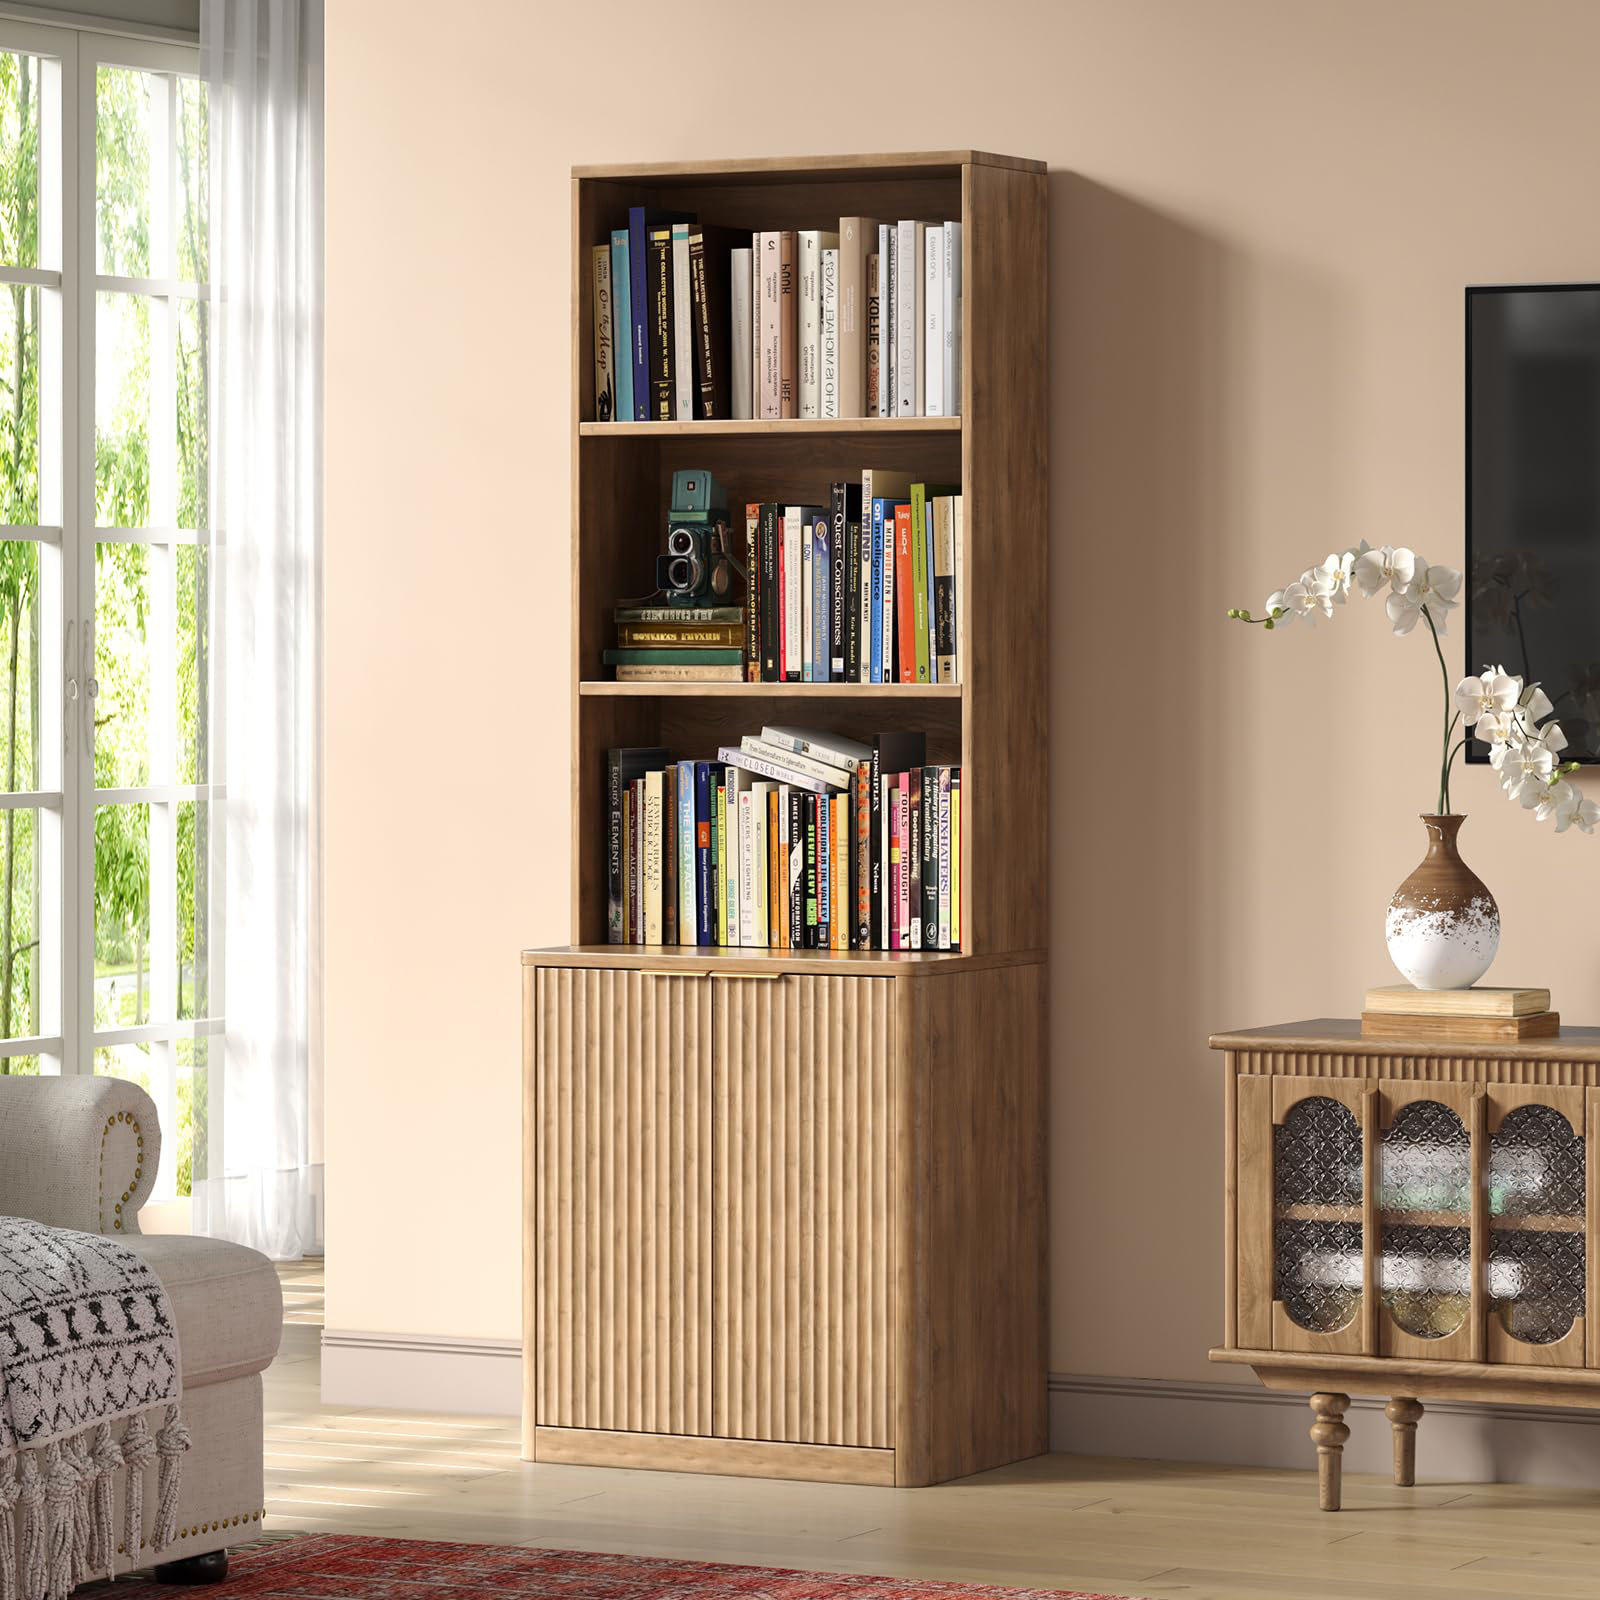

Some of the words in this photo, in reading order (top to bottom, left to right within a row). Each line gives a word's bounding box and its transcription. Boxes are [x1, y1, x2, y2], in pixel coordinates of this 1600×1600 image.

[599, 289, 609, 309] On
[662, 321, 668, 329] OF
[703, 325, 709, 333] OF
[598, 323, 612, 370] Map
[874, 503, 881, 520] on
[834, 513, 844, 550] Quest
[862, 513, 871, 562] MIND
[884, 527, 892, 549] MIND
[901, 527, 909, 556] EDA
[750, 560, 756, 572] OF
[803, 544, 811, 561] FLOW
[853, 558, 858, 566] of
[872, 522, 882, 601] intelligence
[884, 574, 892, 595] OPEN
[834, 559, 844, 646] Consciousness
[743, 758, 776, 777] CLOSED
[611, 766, 619, 806] EUCLID'S
[727, 769, 735, 805] MICROCOSM
[683, 800, 691, 826] THE
[820, 798, 828, 853] REVOLUTION
[924, 797, 932, 832] Twentieth
[611, 811, 621, 874] ELEMENTS
[683, 831, 692, 862] IDEA
[745, 843, 751, 852] OF
[807, 824, 815, 865] STEVEN
[911, 810, 920, 879] Bootstrapping
[923, 833, 932, 862] Century
[931, 820, 939, 859] Computing
[820, 855, 827, 865] IN
[820, 867, 828, 882] THE
[684, 863, 693, 925] FACTORY
[807, 869, 815, 895] LEVY
[820, 886, 828, 918] VALLEY
